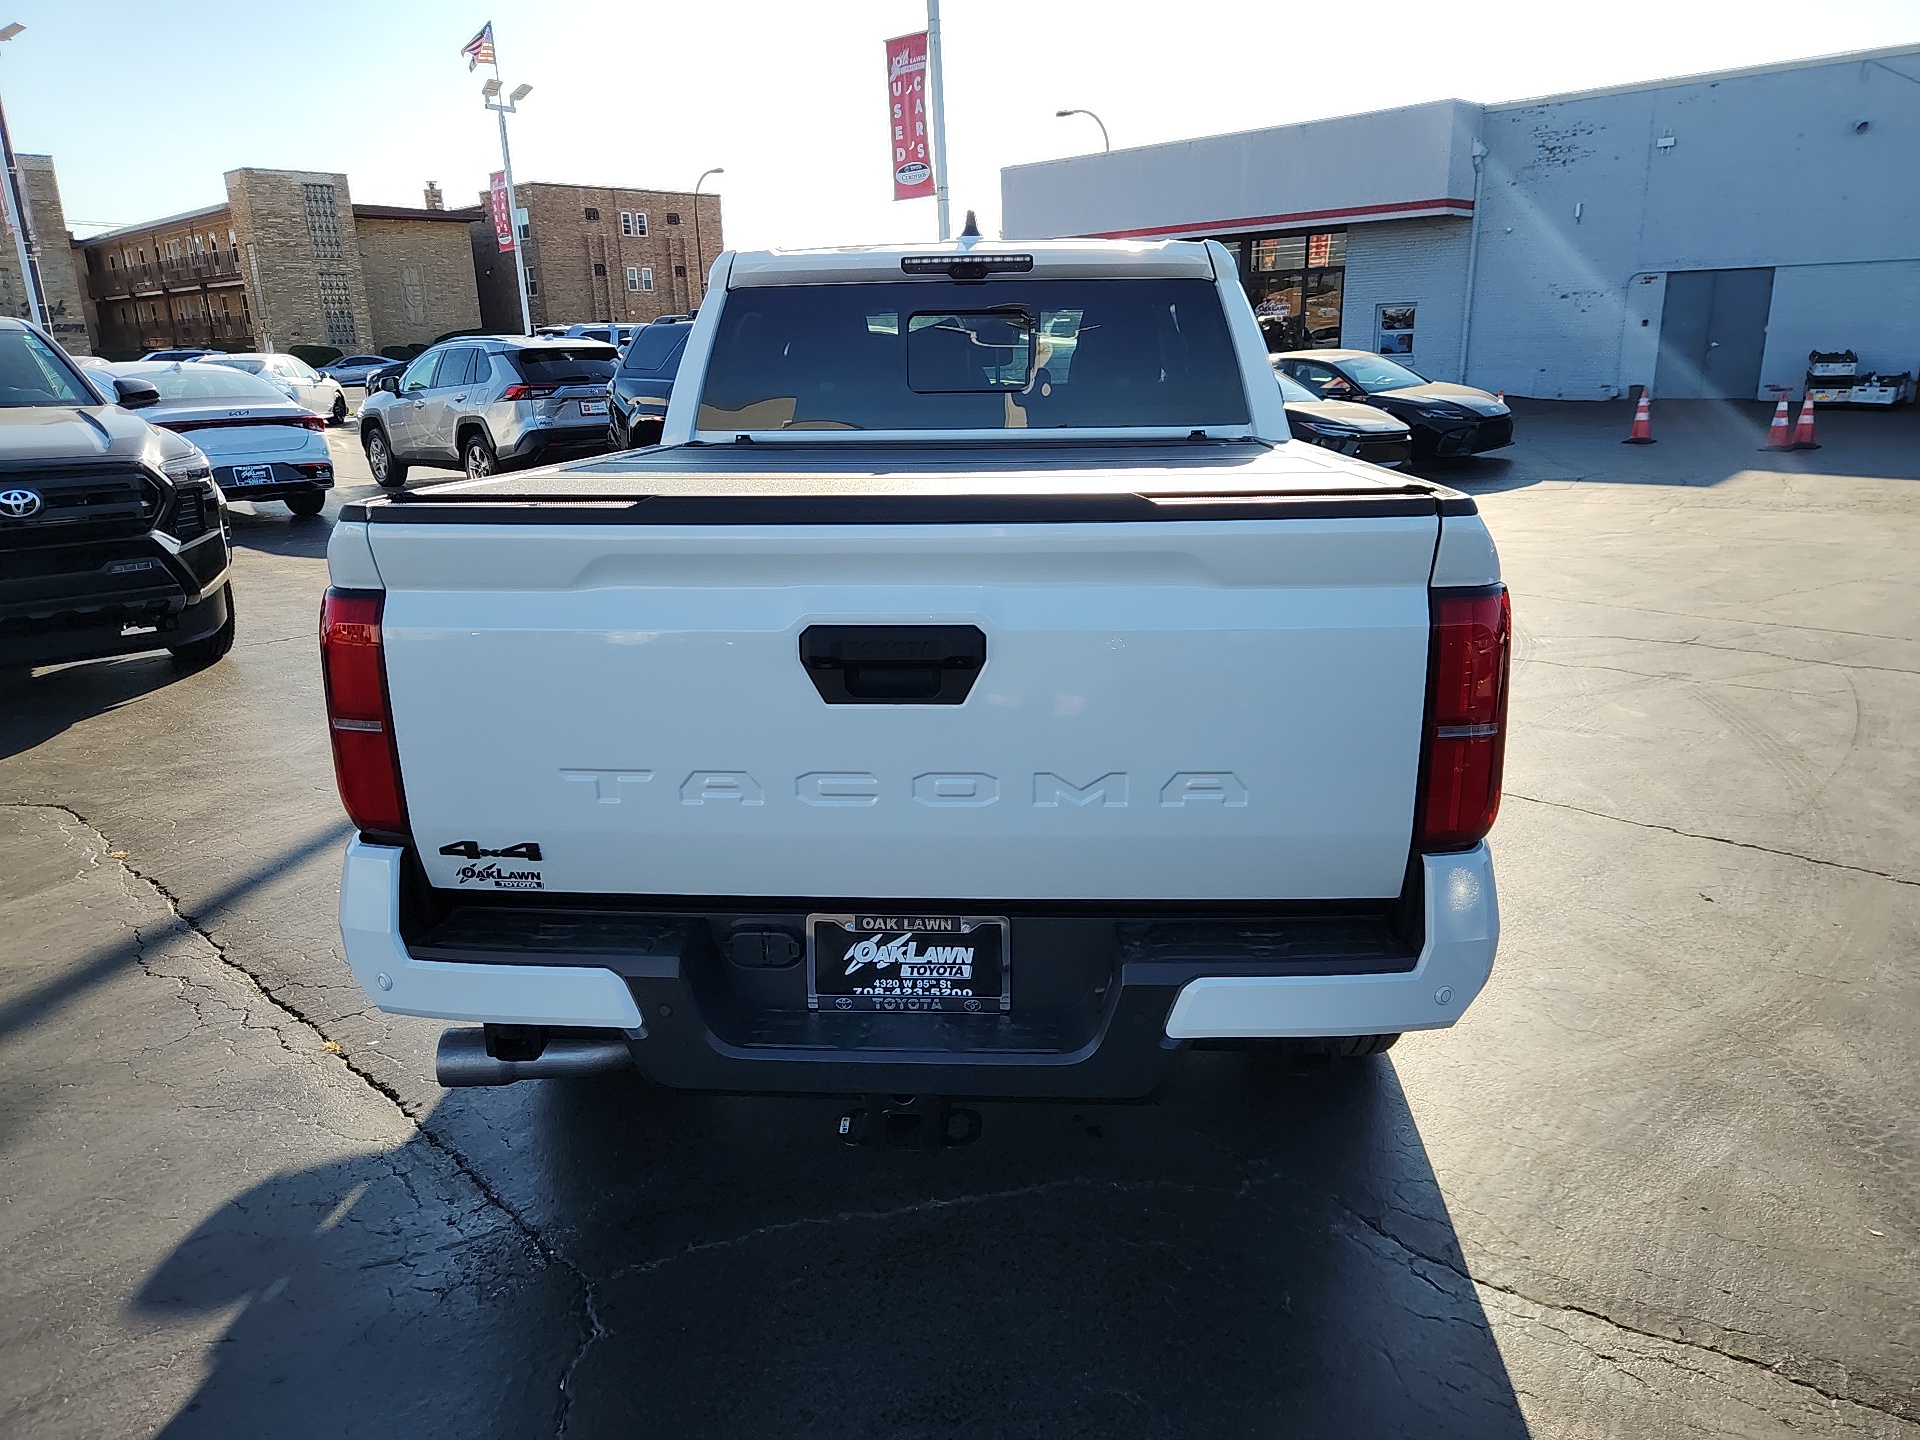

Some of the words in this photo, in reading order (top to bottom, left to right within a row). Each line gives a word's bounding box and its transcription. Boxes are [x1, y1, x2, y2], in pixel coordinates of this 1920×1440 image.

[892, 81, 906, 162] USED
[558, 768, 1250, 808] TACOMA
[862, 917, 899, 930] OAK
[903, 918, 952, 931] LAWN
[908, 965, 965, 977] TOYOTA
[873, 979, 899, 988] 4320
[903, 980, 914, 988] W
[940, 979, 952, 988] St
[872, 998, 943, 1010] TOYOTA
